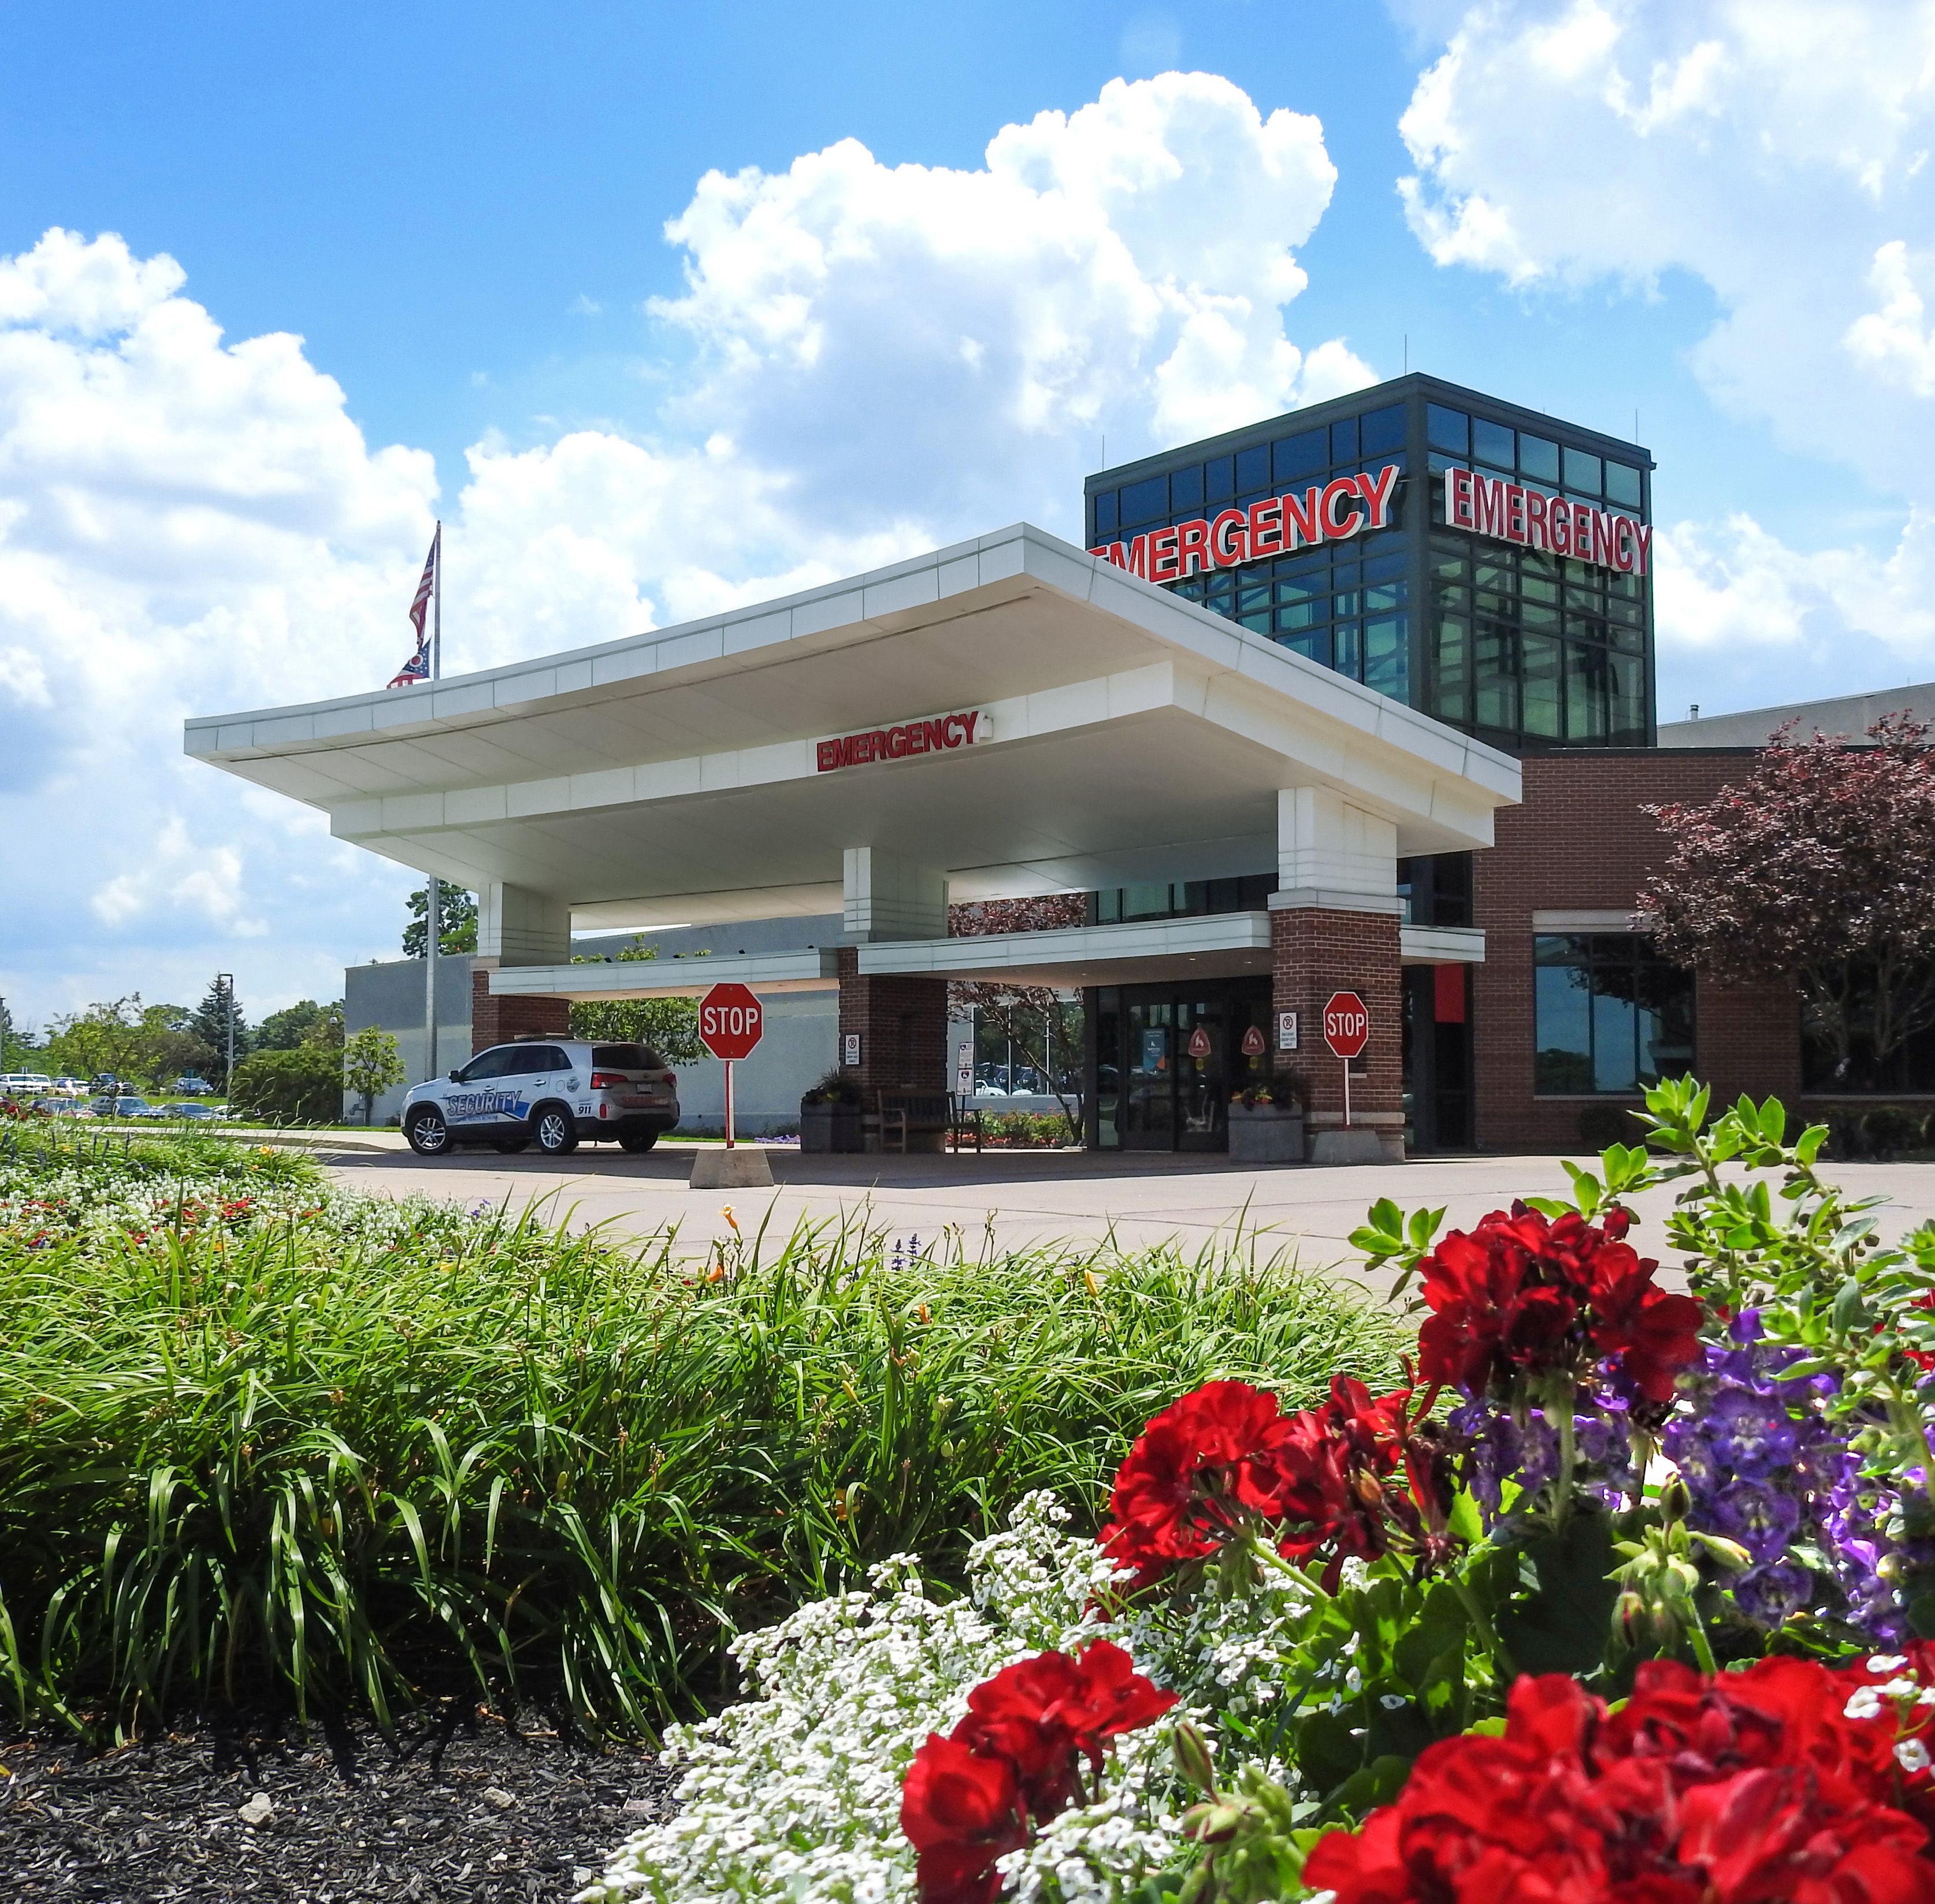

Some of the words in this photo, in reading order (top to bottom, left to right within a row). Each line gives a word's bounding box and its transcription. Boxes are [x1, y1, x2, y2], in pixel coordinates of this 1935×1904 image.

[1087, 465, 1399, 584] MERGENCY
[1446, 467, 1652, 577] EMERGENCY
[816, 711, 981, 772] EMERGENCY
[704, 1007, 759, 1035] STOP
[1327, 1012, 1365, 1037] STOP
[447, 1090, 522, 1116] SECURITY
[578, 1106, 592, 1115] 911
